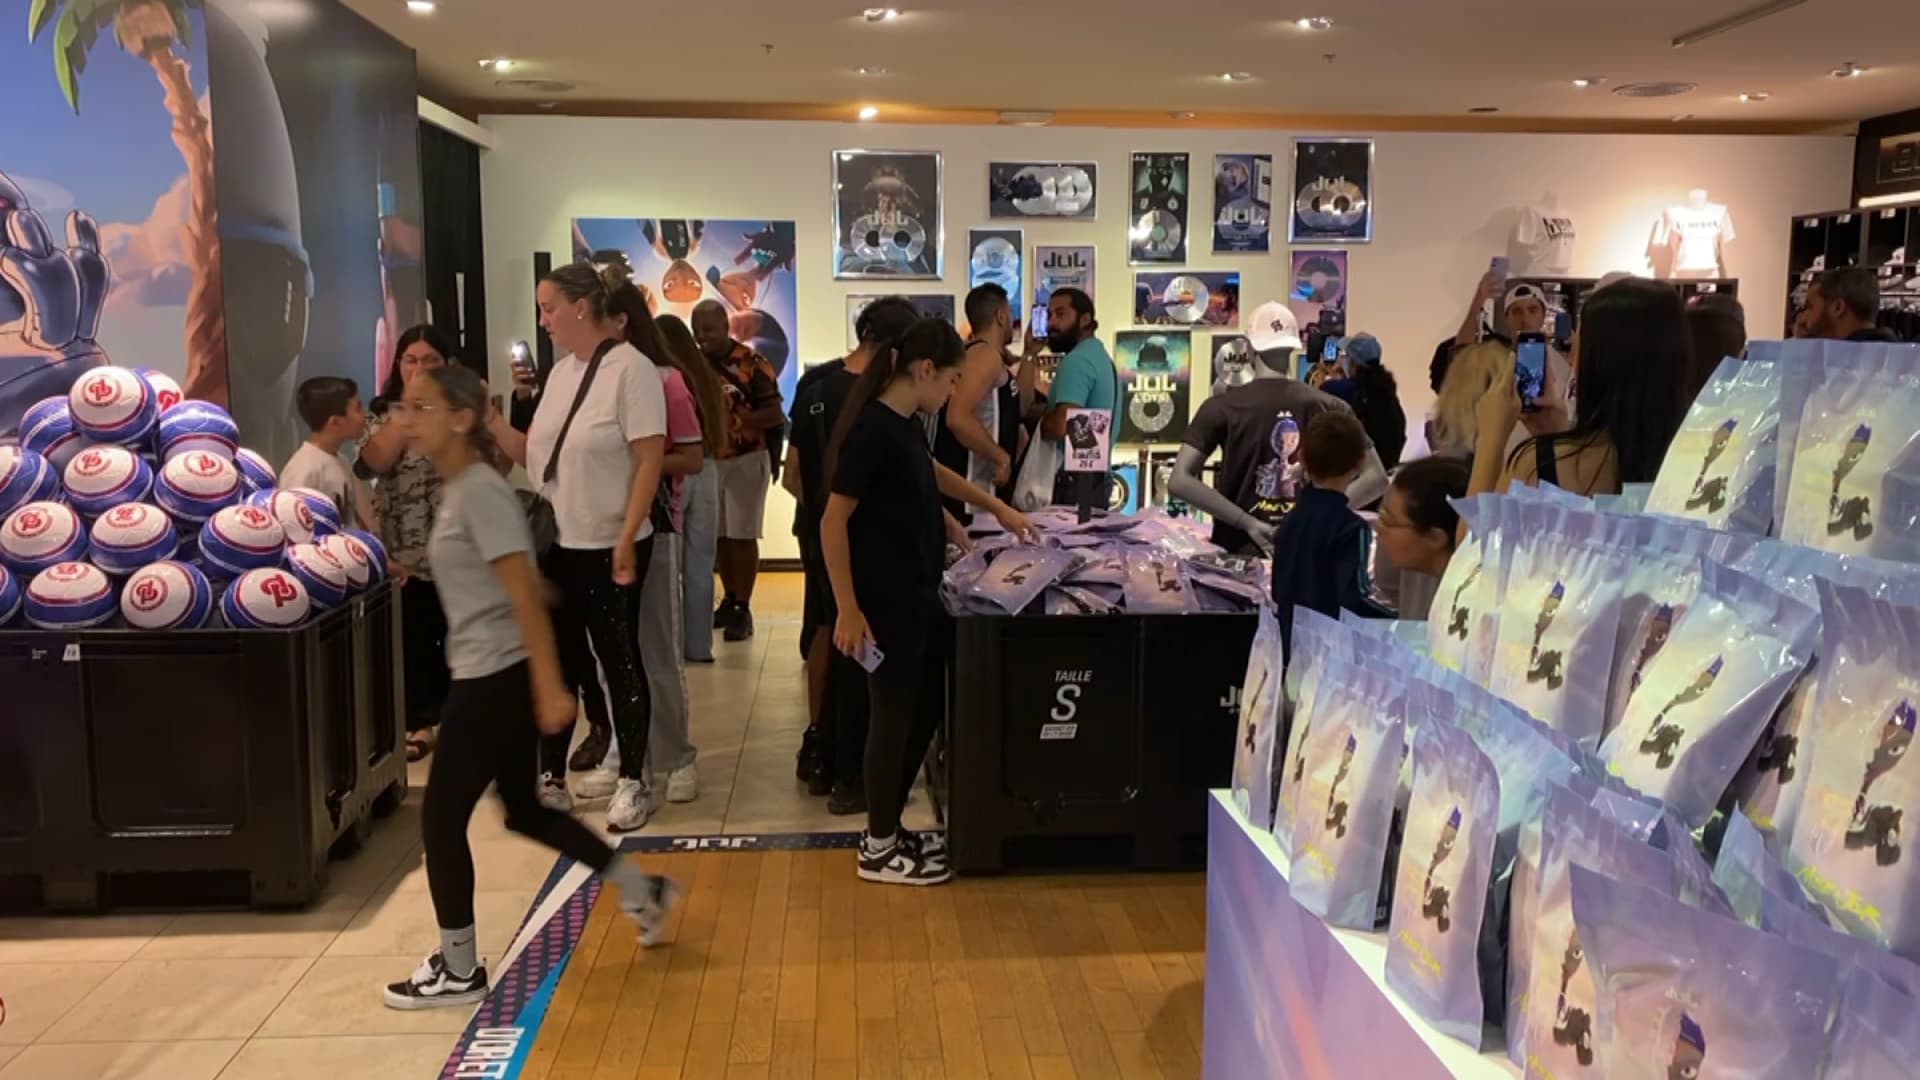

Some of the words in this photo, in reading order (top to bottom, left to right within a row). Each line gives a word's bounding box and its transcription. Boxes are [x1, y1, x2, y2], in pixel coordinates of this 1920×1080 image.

[1043, 251, 1086, 268] JUL
[1127, 373, 1177, 391] JUL
[1055, 669, 1093, 682] TAILLE
[1050, 683, 1081, 721] S
